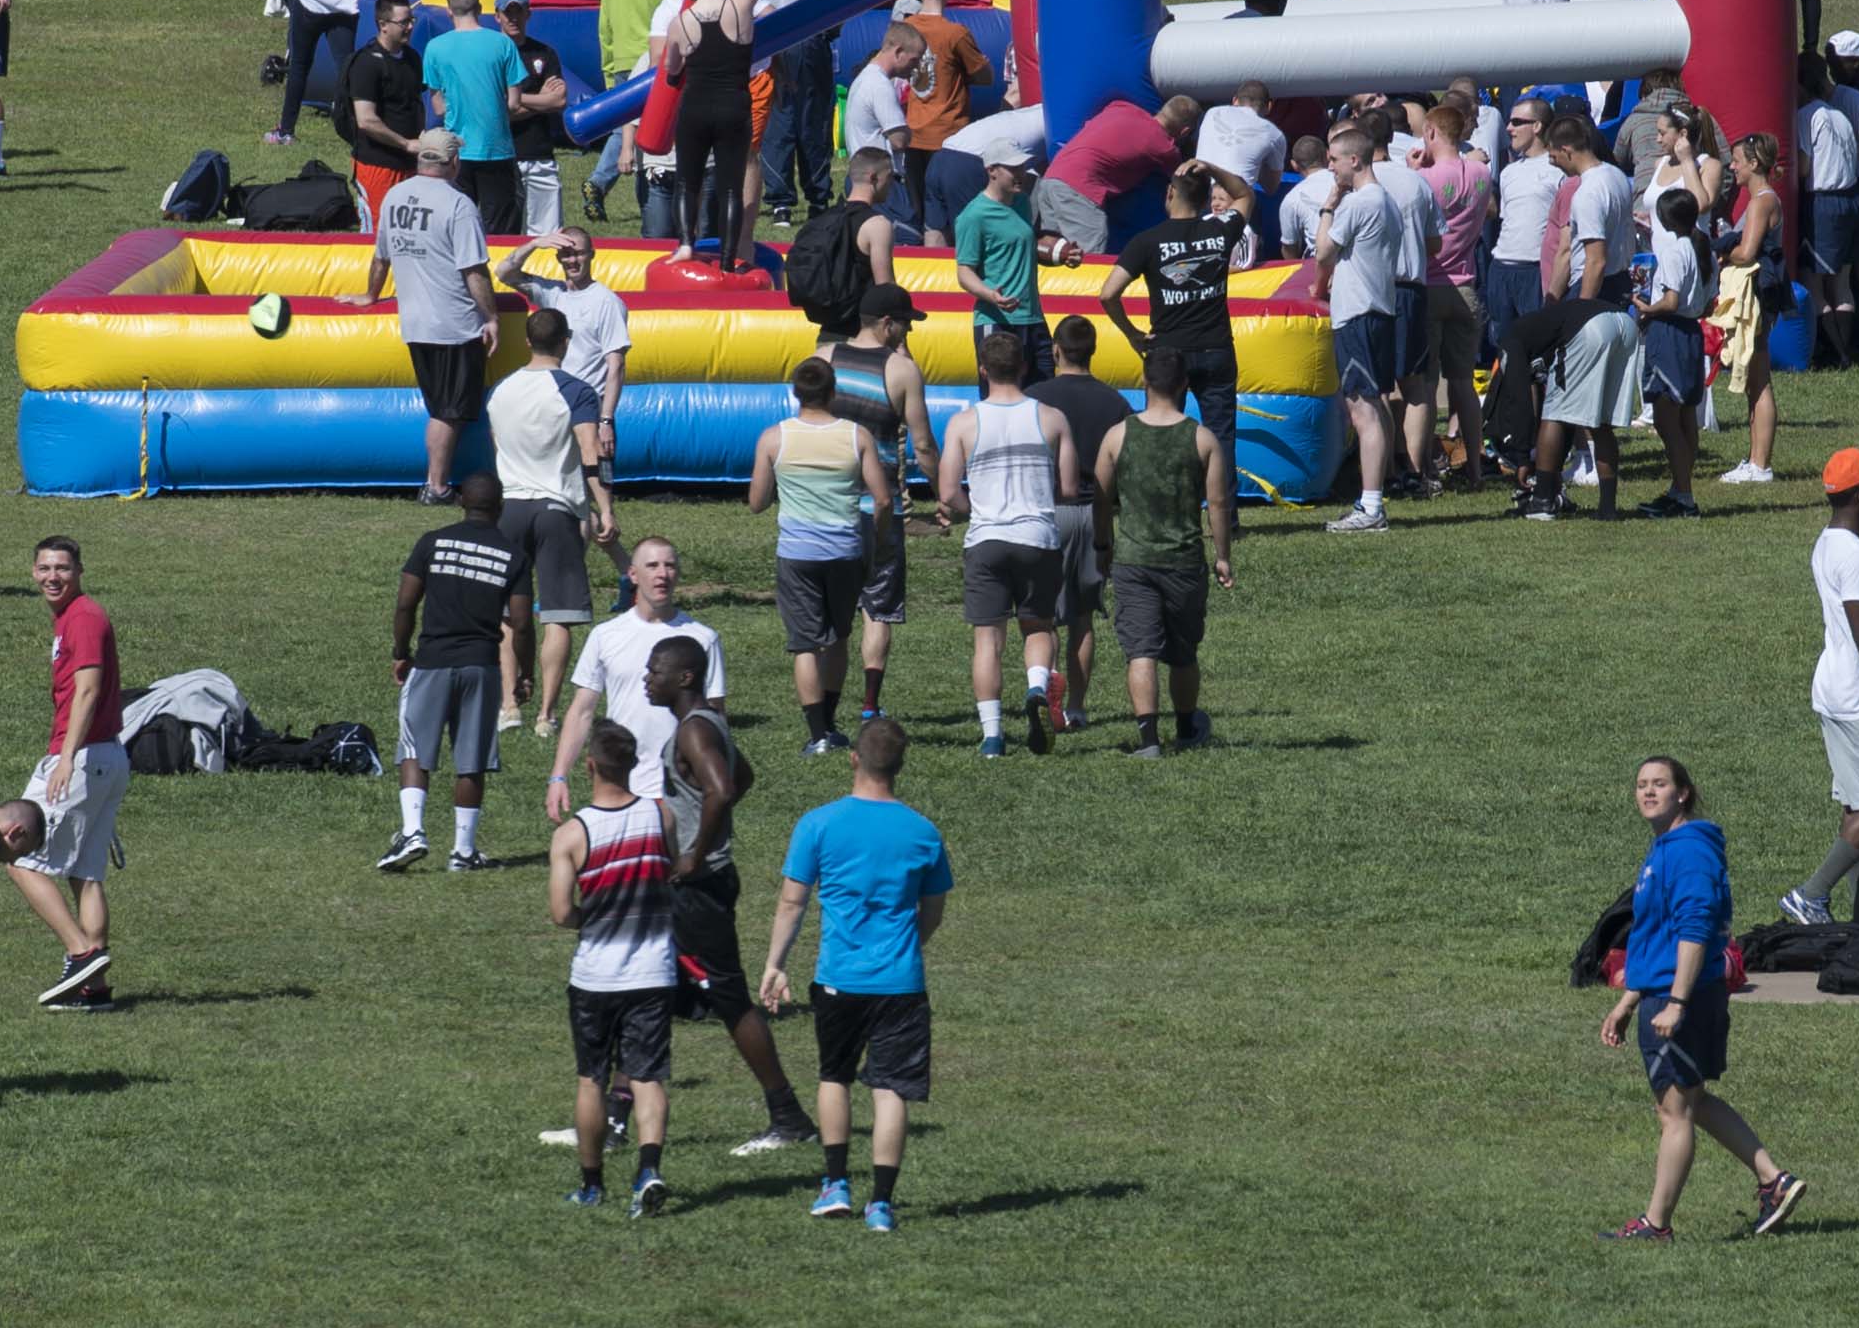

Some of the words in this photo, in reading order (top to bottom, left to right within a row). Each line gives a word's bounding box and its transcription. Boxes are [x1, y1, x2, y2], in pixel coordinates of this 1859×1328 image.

[390, 205, 433, 231] LOFT
[1159, 241, 1186, 261] 331
[1191, 236, 1225, 252] TRS
